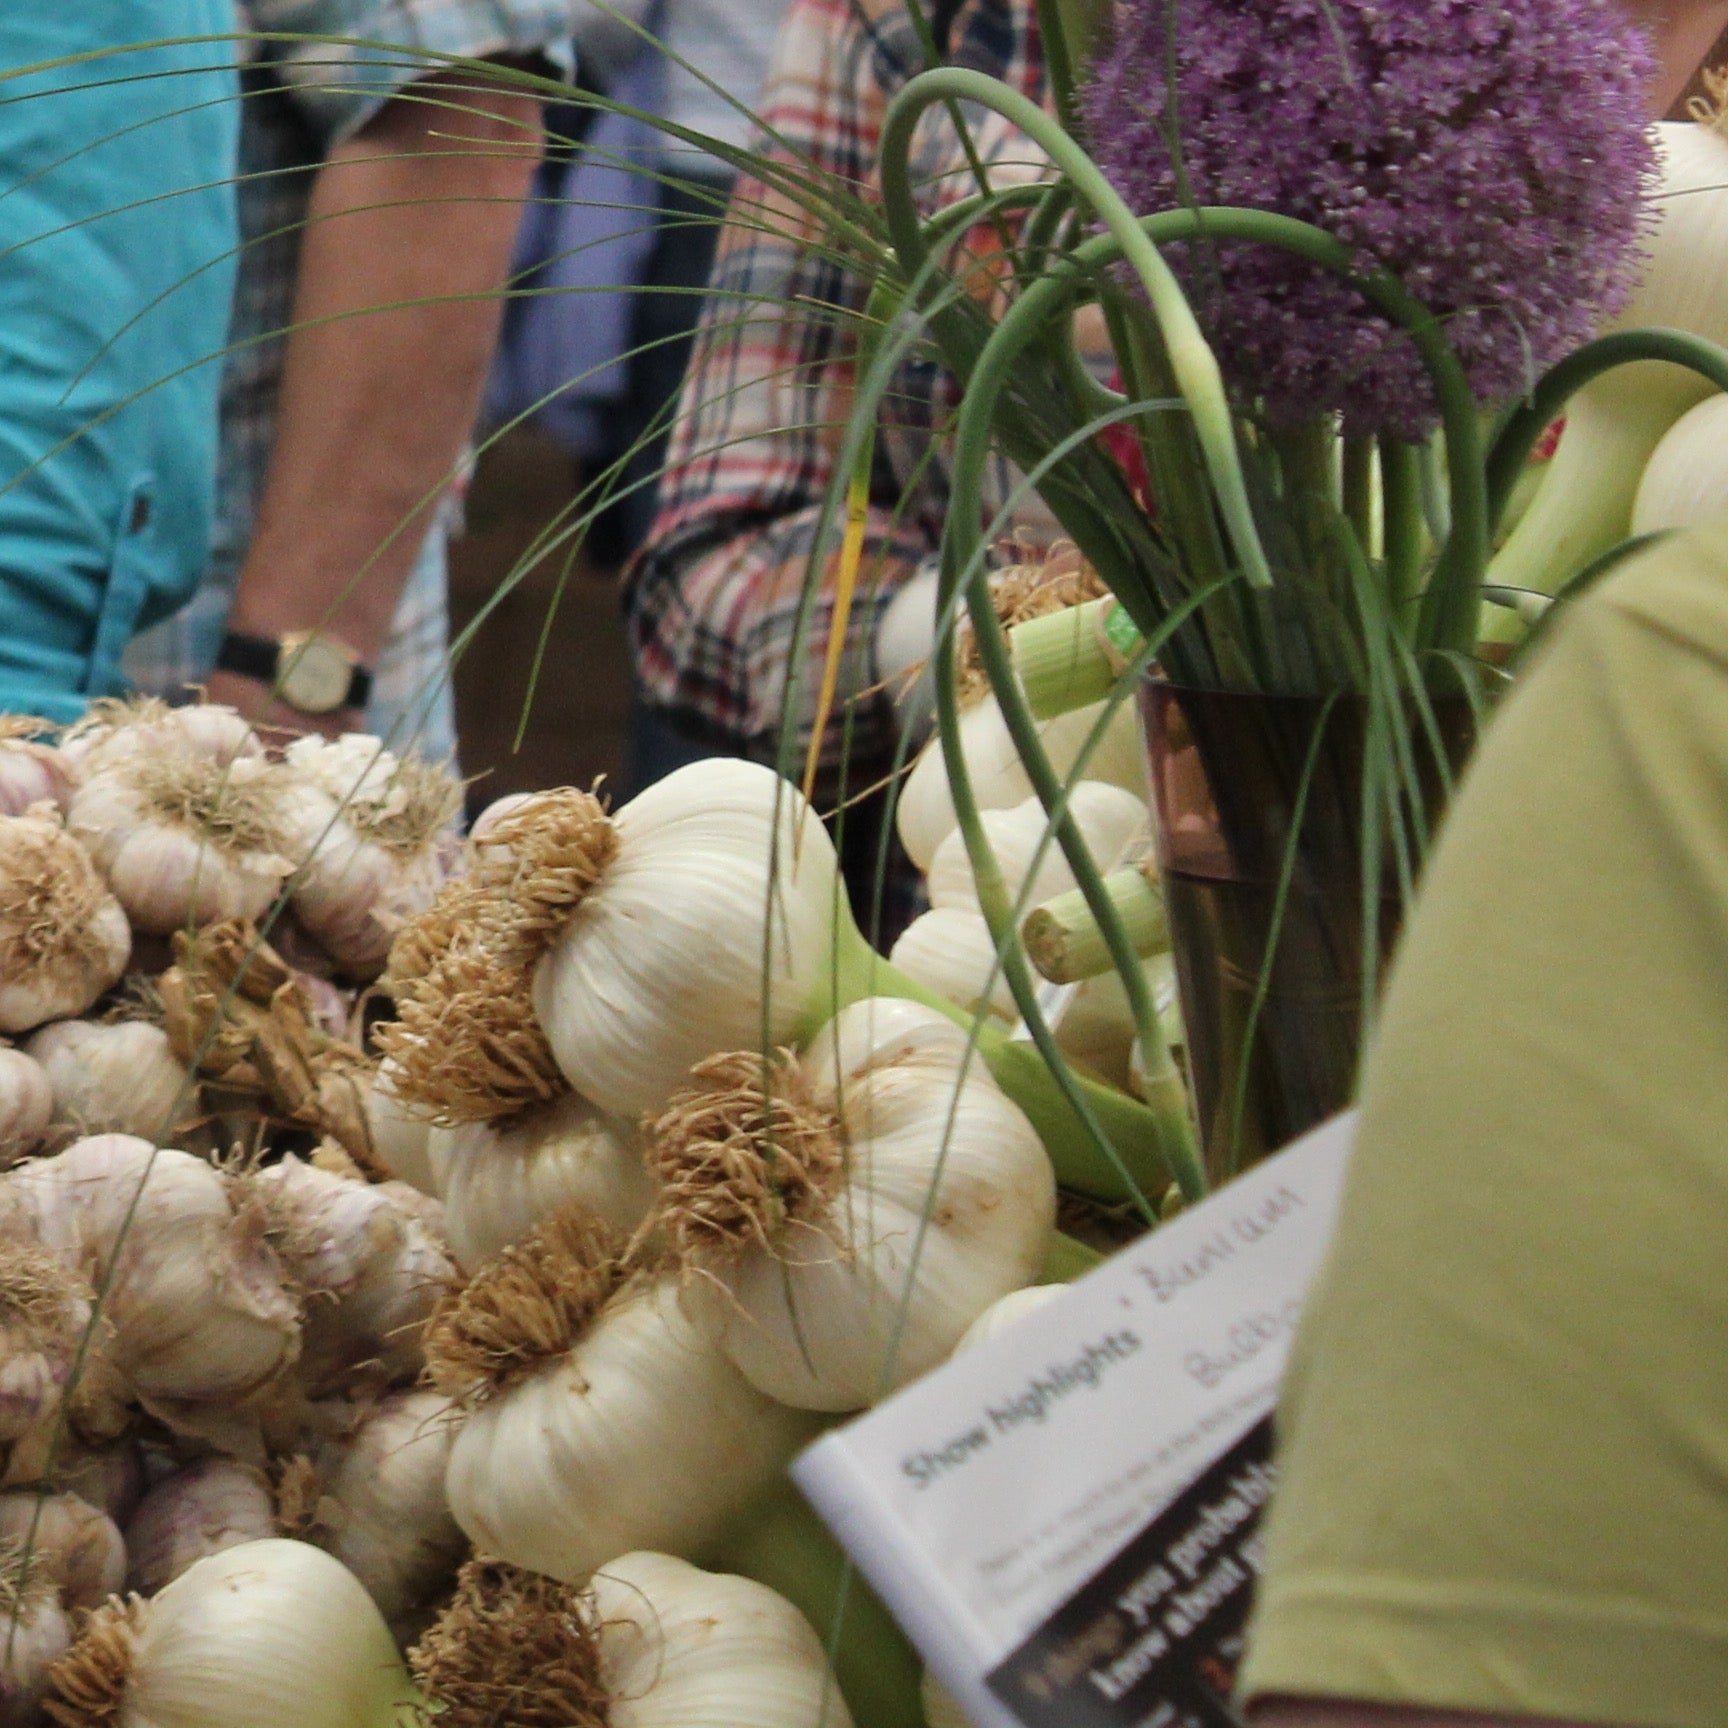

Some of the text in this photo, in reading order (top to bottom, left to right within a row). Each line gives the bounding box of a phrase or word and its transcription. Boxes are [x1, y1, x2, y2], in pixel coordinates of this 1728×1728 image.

[900, 1426, 991, 1492] Show
[985, 1329, 1144, 1436] highlights
[1114, 1561, 1179, 1628] you
[1088, 1624, 1172, 1703] know
